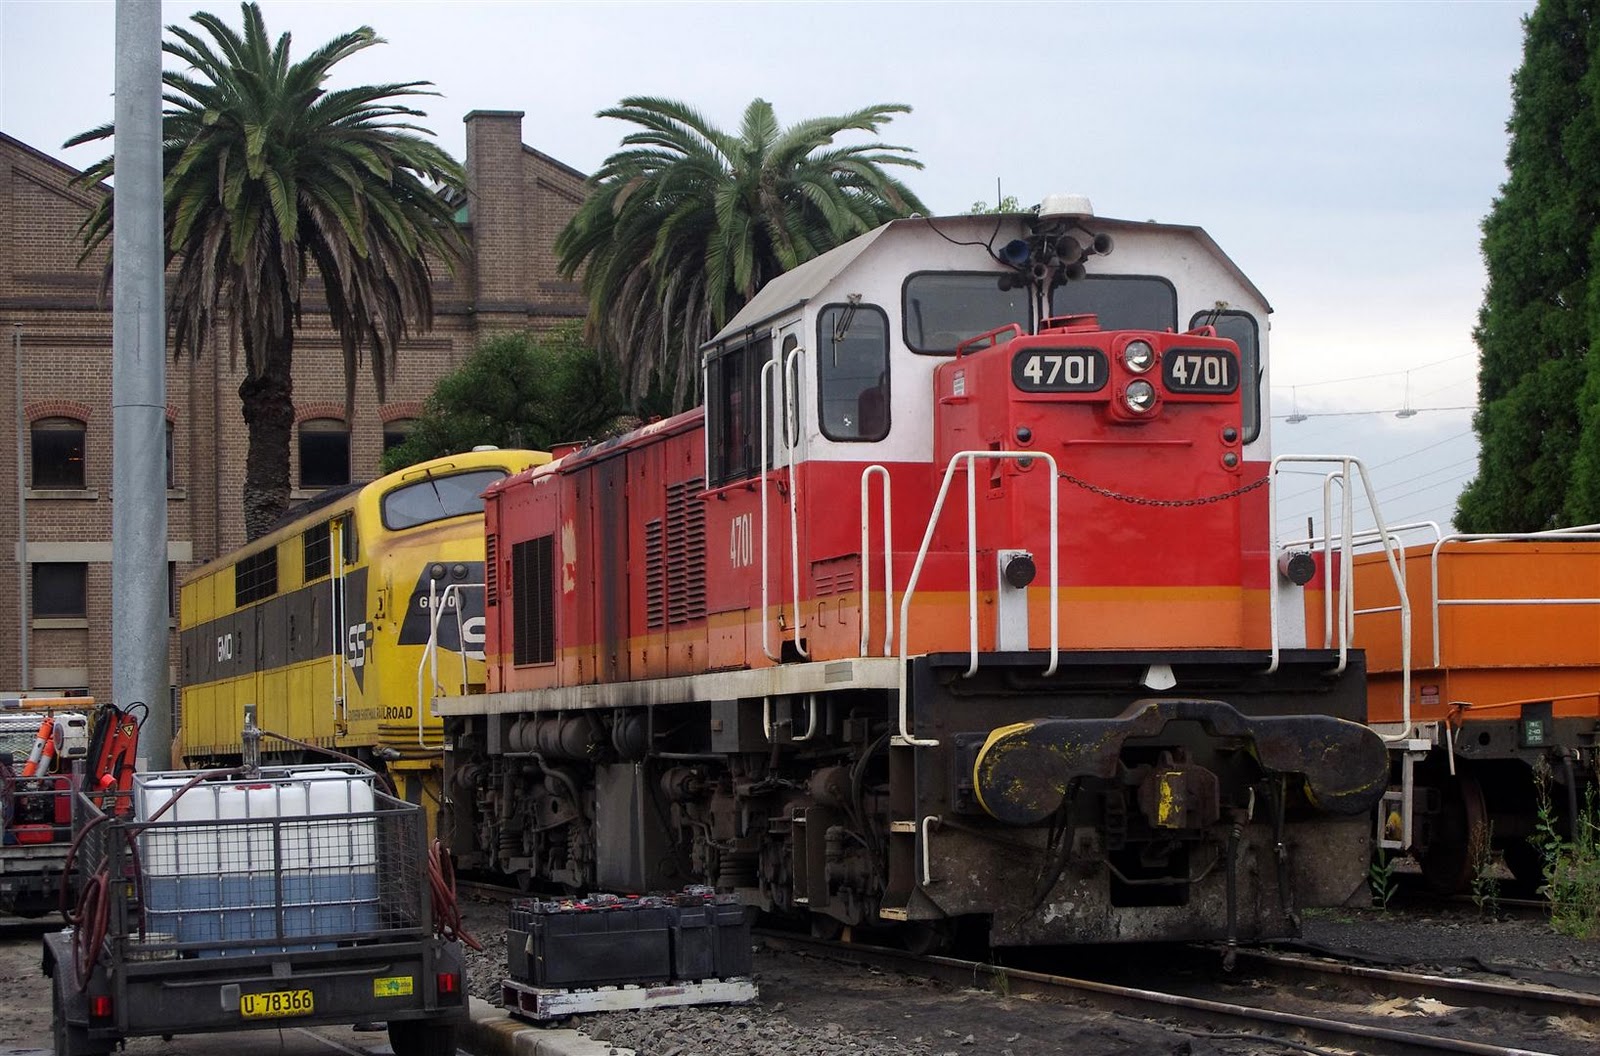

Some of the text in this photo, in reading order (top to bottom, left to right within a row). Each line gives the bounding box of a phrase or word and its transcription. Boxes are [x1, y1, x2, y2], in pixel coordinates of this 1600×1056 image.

[1023, 355, 1094, 385] 4701
[1172, 355, 1228, 386] 4701
[730, 512, 753, 569] 4701
